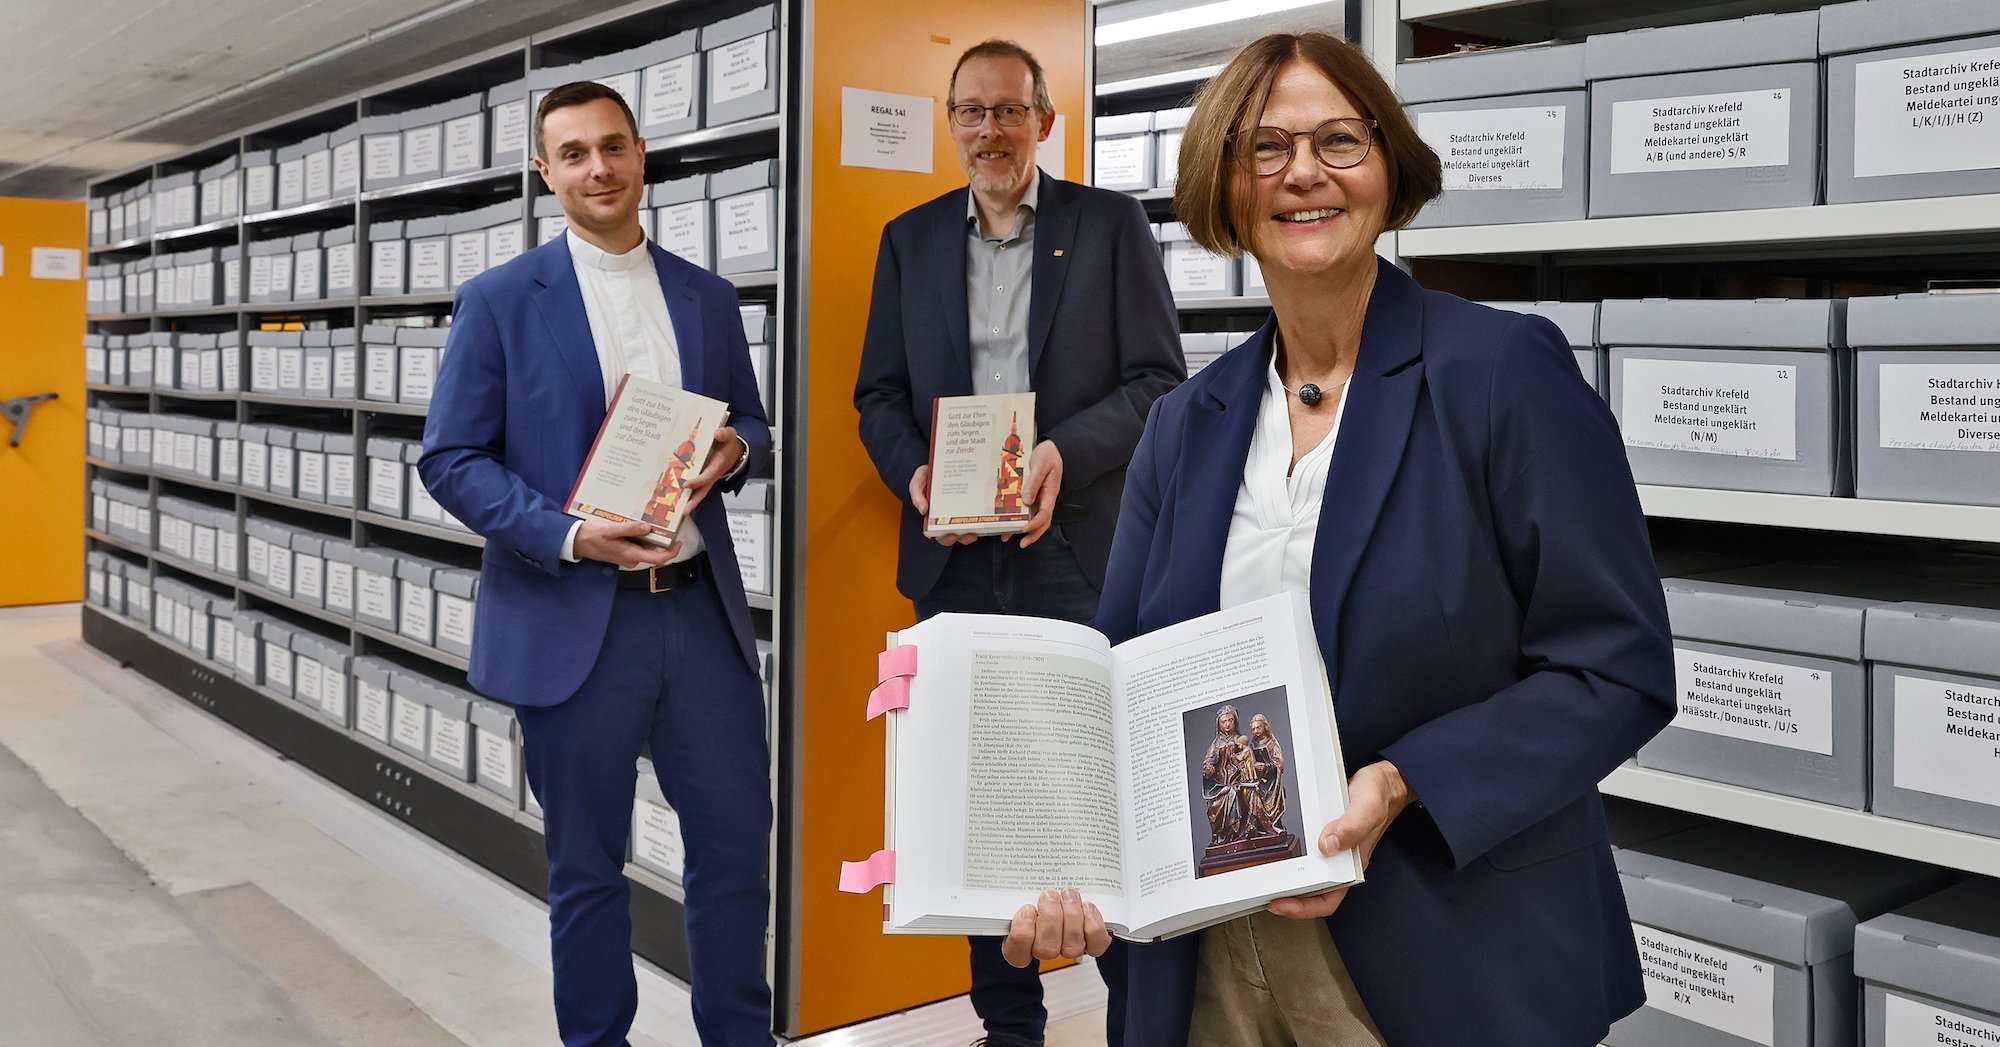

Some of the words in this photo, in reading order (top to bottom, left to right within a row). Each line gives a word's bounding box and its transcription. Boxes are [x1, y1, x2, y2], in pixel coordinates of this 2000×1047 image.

[1903, 63, 1967, 79] Stadtarchiv
[1970, 59, 2000, 72] Krefe
[1905, 81, 1950, 95] Bestand
[1953, 76, 1999, 92] ungeklä
[871, 105, 893, 116] REGAL
[1652, 105, 1706, 118] Stadtarchiv
[1708, 102, 1743, 113] Krefeld
[1906, 95, 1973, 112] Meldekartei
[1968, 111, 1983, 124] (Z)
[1653, 120, 1691, 132] Bestand
[1694, 118, 1740, 131] ungeklärt
[1450, 132, 1494, 143] Stadtarchiv
[1496, 131, 1525, 141] Krefeld
[1644, 134, 1700, 147] Meldekartei
[1702, 132, 1749, 146] ungeklärt
[1451, 147, 1482, 156] Bestand
[1484, 146, 1523, 157] ungeklärt
[1646, 152, 1663, 163] A/B
[1666, 151, 1686, 162] (und
[1689, 148, 1725, 160] andere)
[1728, 147, 1746, 159] S/R
[1443, 160, 1490, 169] Meldekartei
[1491, 159, 1530, 170] ungeklärt
[1468, 174, 1502, 182] Diverses
[1777, 370, 1788, 379] 22
[1928, 378, 1994, 389] Stadtarchiv
[1661, 385, 1713, 398] Stadtarchiv
[1715, 388, 1750, 399] Krefeld
[631, 395, 646, 406] Gott
[1663, 400, 1700, 411] Bestand
[1702, 403, 1747, 415] ungeklärt
[1930, 395, 1976, 406] Bestand
[627, 405, 640, 414] den
[640, 408, 672, 423] Gläubigen
[1920, 411, 1987, 423] Meldekartei
[624, 415, 638, 423] zum
[638, 418, 658, 429] Segen
[960, 420, 990, 428] Gläubigen
[1654, 414, 1709, 427] Meldekartei
[1710, 418, 1757, 431] ungeklärt
[615, 432, 626, 440] zur
[625, 434, 646, 446] Zierde
[620, 424, 633, 432] und
[633, 427, 644, 435] der
[644, 429, 661, 440] Stadt
[1690, 430, 1718, 443] (N/M)
[1958, 428, 2000, 440] Diverse
[970, 437, 986, 445] Stadt
[956, 446, 975, 454] Zierde
[1693, 662, 1747, 679] Stadtarchiv
[1749, 671, 1784, 685] Krefeld
[1695, 677, 1732, 692] Bestand
[1735, 684, 1782, 700] ungeklärt
[1687, 691, 1742, 709] Meldekartei
[1744, 701, 1792, 717] ungeklärt
[1945, 689, 2000, 707] Stadtarch
[1947, 706, 1994, 723] Bestand
[1774, 720, 1798, 734] /U/S
[1946, 723, 2000, 741] Meldekar
[1640, 936, 1692, 960] Stadtarchiv
[1694, 953, 1728, 971] Krefeld
[1642, 951, 1678, 971] Bestand
[1681, 964, 1725, 985] ungeklärt
[1641, 967, 1687, 989] eldekartei
[1689, 982, 1735, 1004] ungeklärt
[1674, 991, 1691, 1005] R/X
[1937, 1032, 1984, 1047] Bestan
